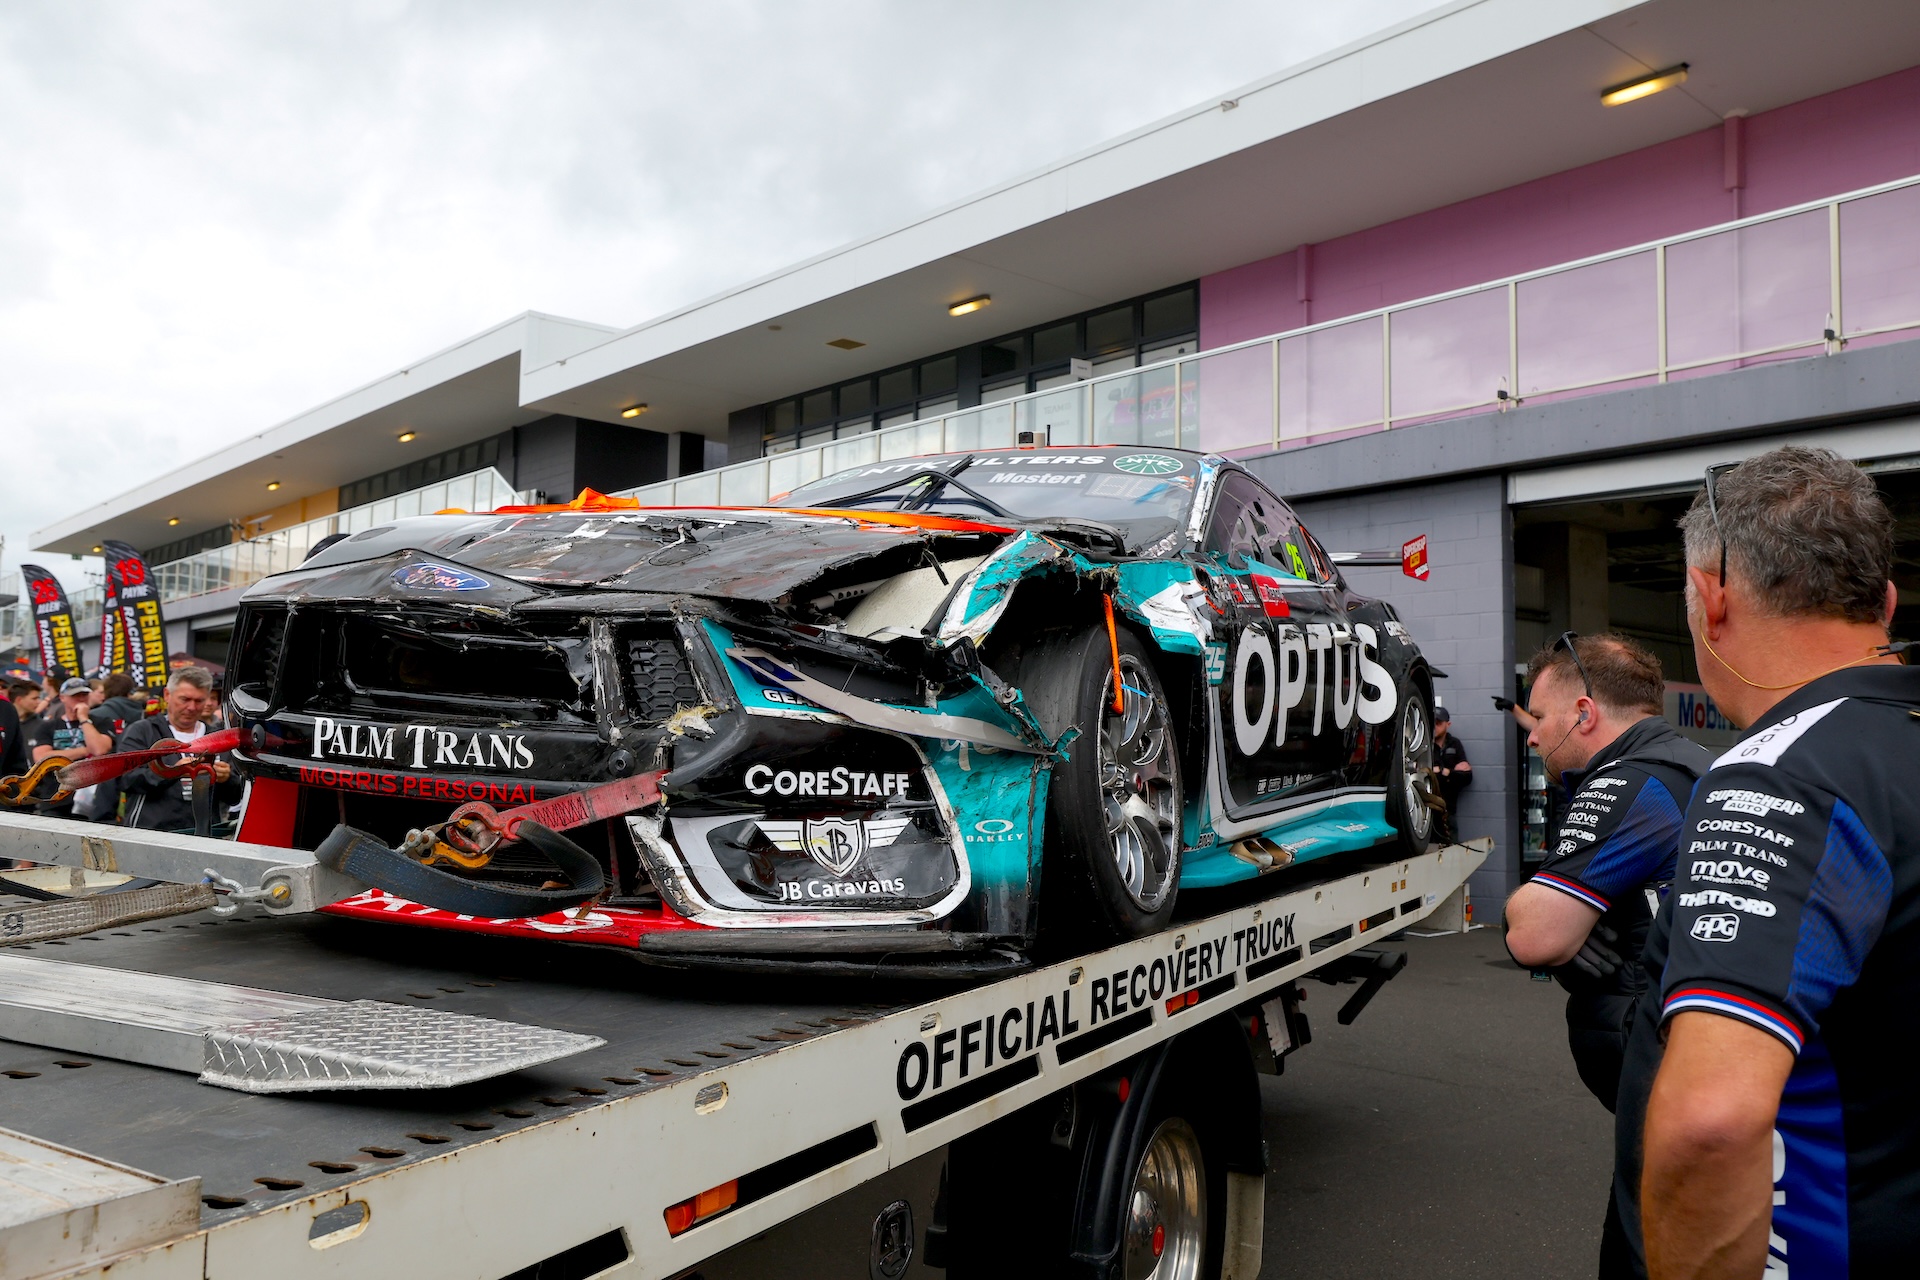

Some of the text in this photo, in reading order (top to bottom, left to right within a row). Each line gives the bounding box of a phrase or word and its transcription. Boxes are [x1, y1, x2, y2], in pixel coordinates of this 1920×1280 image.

[859, 460, 948, 477] NTK
[1127, 457, 1174, 467] NTK
[988, 472, 1087, 485] Mostert
[115, 557, 145, 586] 19
[405, 565, 473, 587] Ford
[121, 585, 149, 599] PAYNE
[36, 601, 61, 615] ALLEN
[39, 620, 56, 668] RACING
[102, 613, 113, 666] RACING
[122, 606, 143, 664] RACING
[136, 600, 167, 688] PENRITE
[1233, 622, 1398, 757] OPTUS
[311, 717, 535, 770] PALM TRANS
[300, 765, 540, 803] MORRIS PERSONAL
[1585, 801, 1611, 813] TRANS
[1705, 789, 1805, 815] SUPERCHEAP
[1727, 802, 1763, 813] AUTO
[1567, 812, 1599, 824] move
[966, 832, 1025, 843] OAKLEY
[1688, 840, 1788, 868] PALM TRANS
[1690, 860, 1771, 884] move
[778, 877, 905, 902] JB Caravans
[1678, 889, 1777, 917] THETFORD
[1694, 917, 1736, 939] PPG
[896, 912, 1297, 1102] OFFICIAL RECOVERY TRUCK
